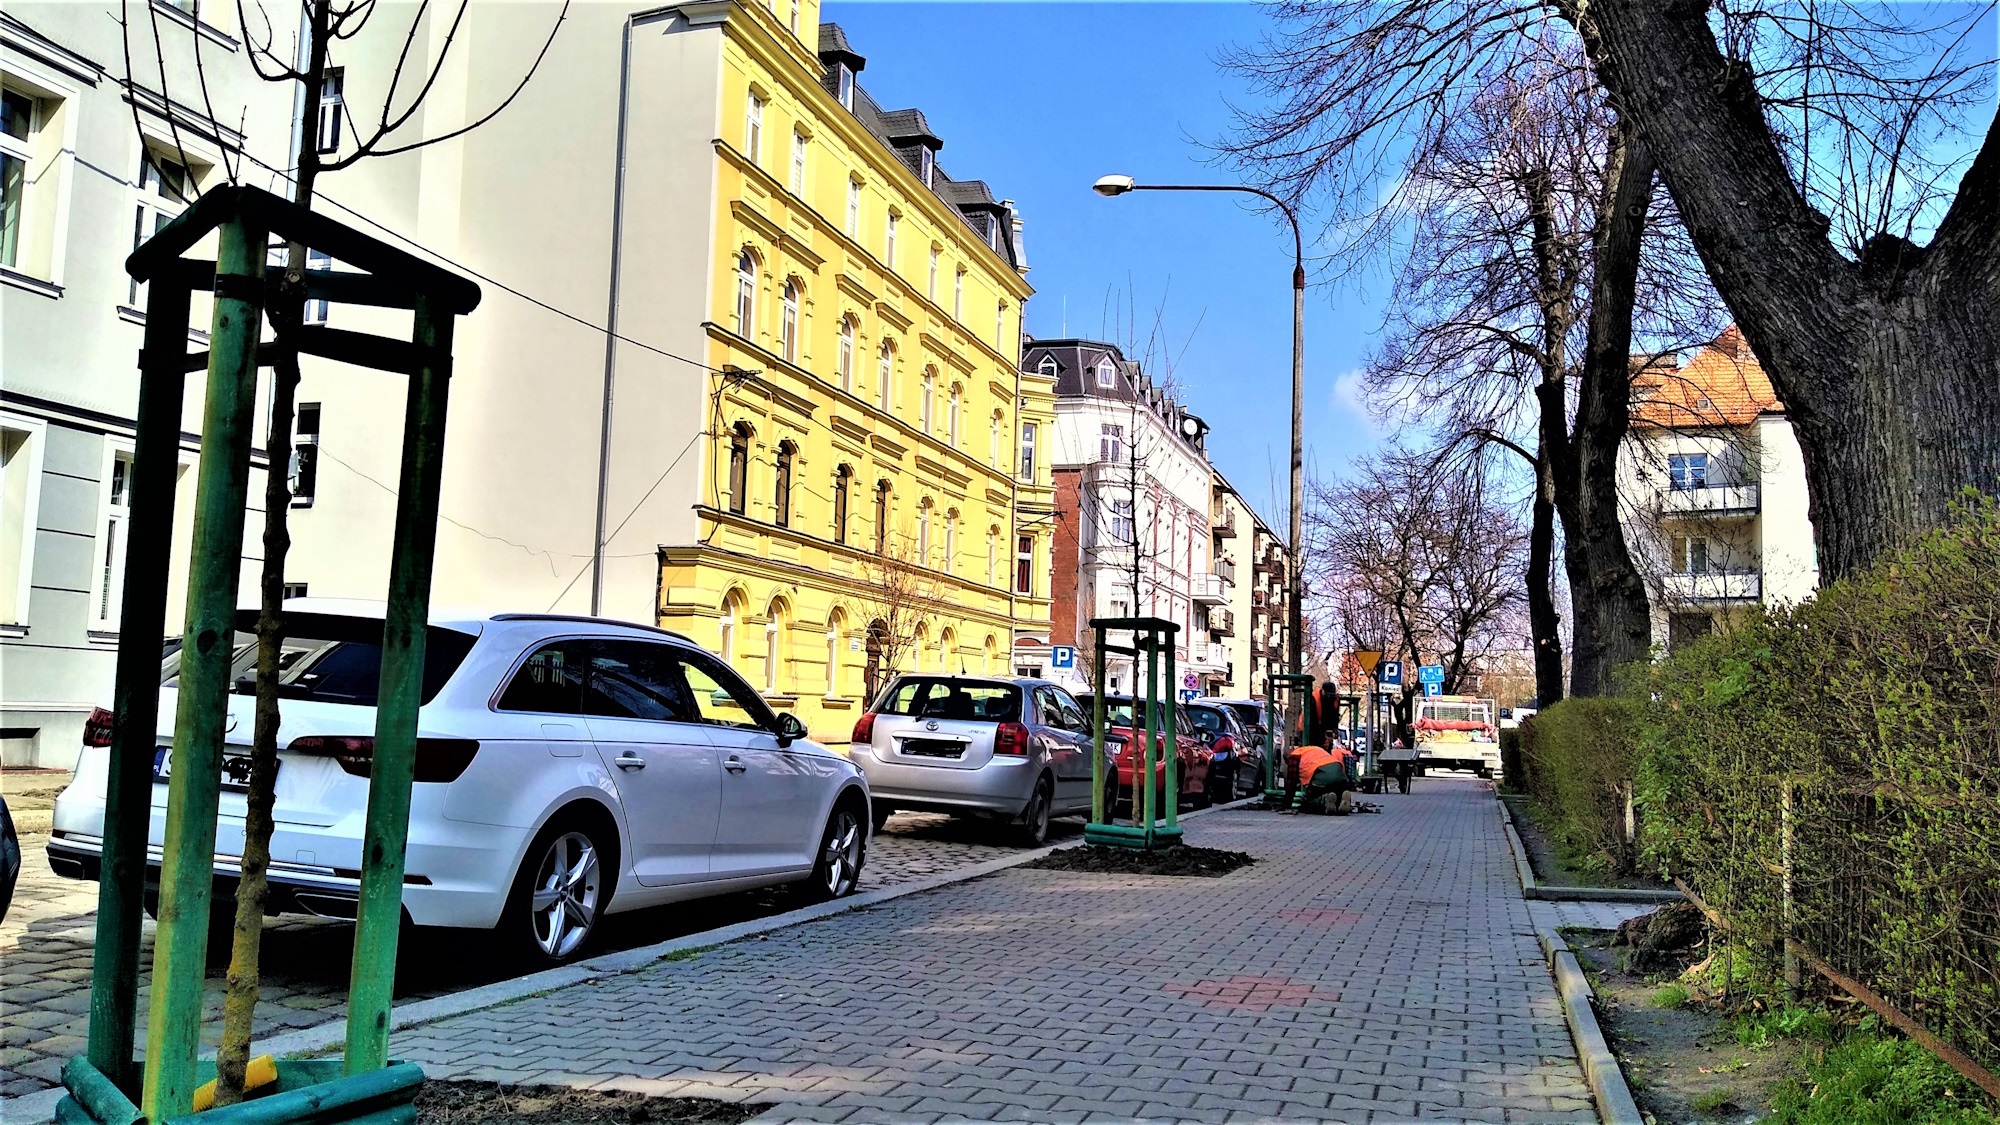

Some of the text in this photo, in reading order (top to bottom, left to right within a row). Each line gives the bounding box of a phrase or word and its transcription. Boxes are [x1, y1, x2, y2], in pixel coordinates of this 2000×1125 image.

[1056, 647, 1070, 665] P
[1384, 662, 1398, 681] P
[1428, 683, 1438, 696] P
